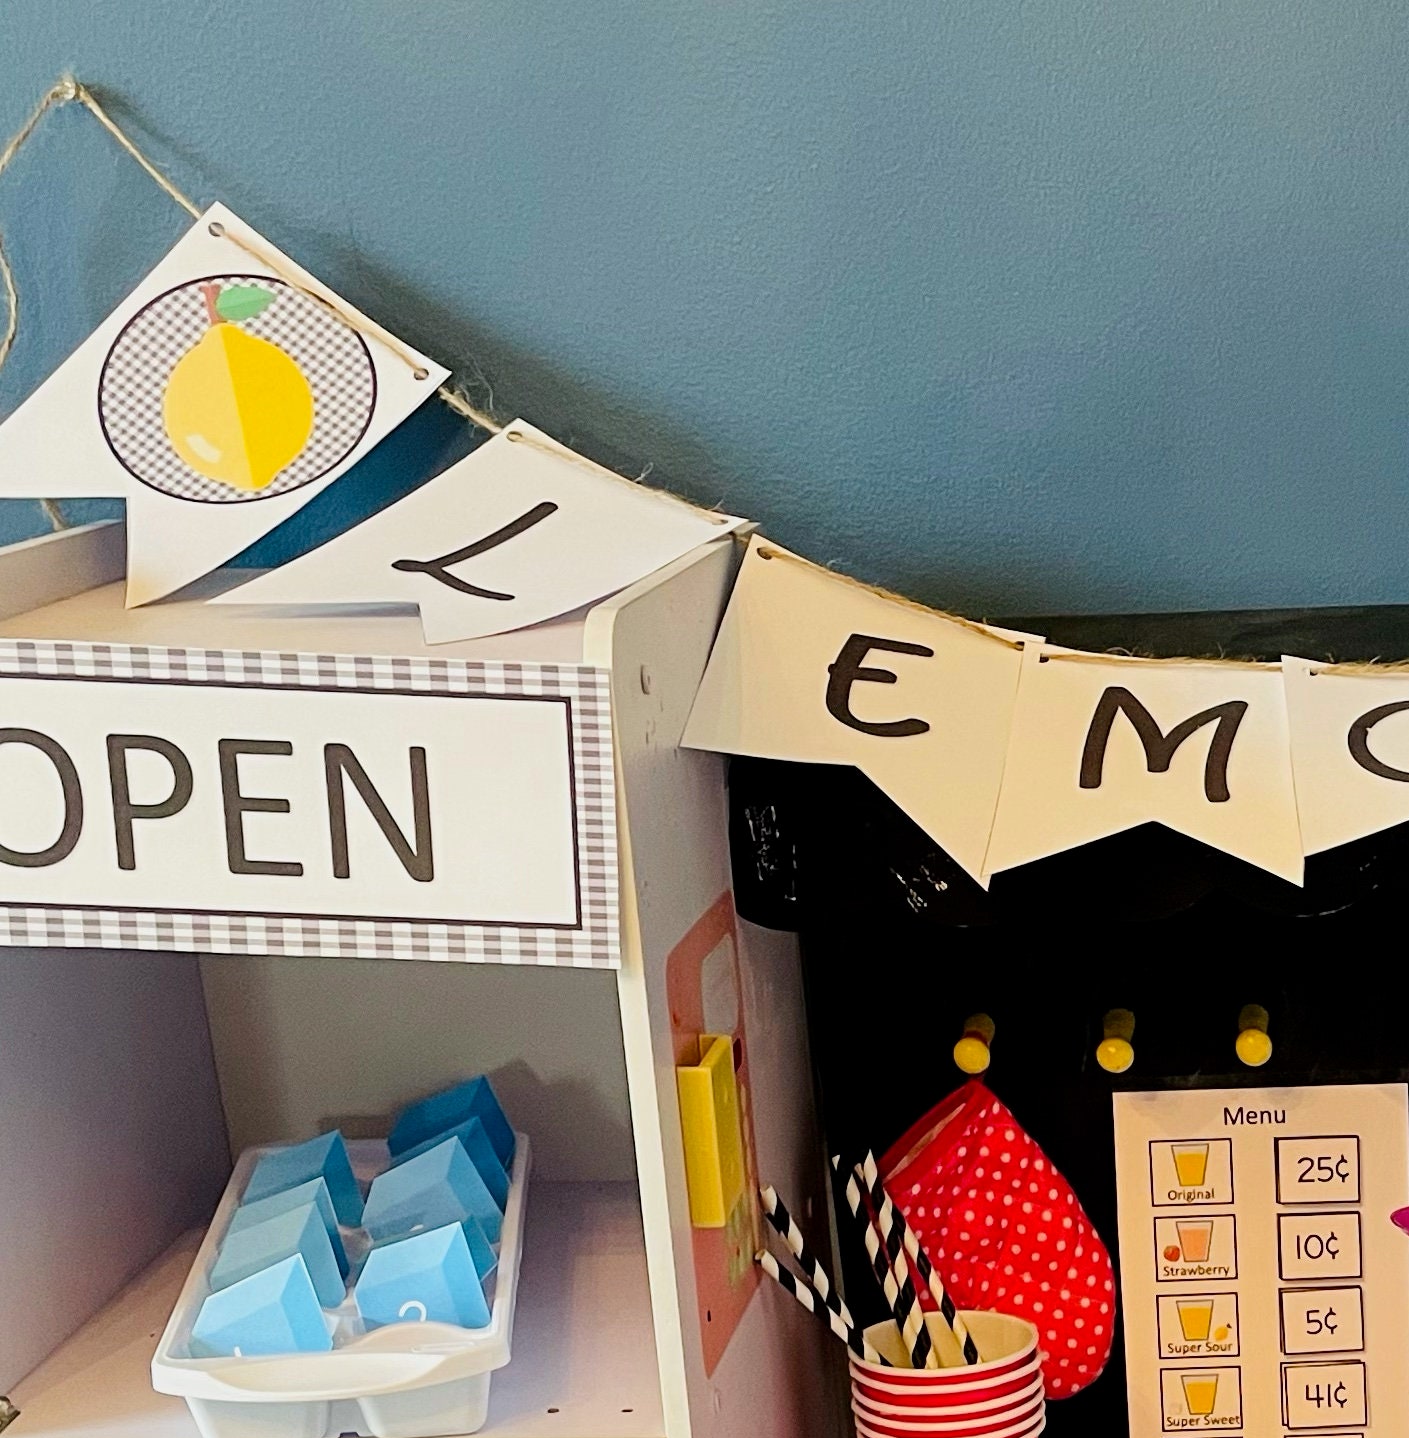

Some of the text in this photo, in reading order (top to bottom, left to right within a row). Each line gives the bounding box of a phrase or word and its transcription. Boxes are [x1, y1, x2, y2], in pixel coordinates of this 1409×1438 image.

[0, 727, 434, 882] OPEN
[1223, 1106, 1287, 1126] Menu
[1297, 1154, 1350, 1184] 25¢
[1167, 1188, 1216, 1203] Original
[1296, 1231, 1341, 1261] 10¢
[1163, 1264, 1230, 1278] Strawberry
[1305, 1307, 1339, 1336] 5¢
[1167, 1341, 1233, 1356] Super Sour
[1305, 1381, 1348, 1409] 41¢
[1166, 1413, 1242, 1430] Super Sweet
